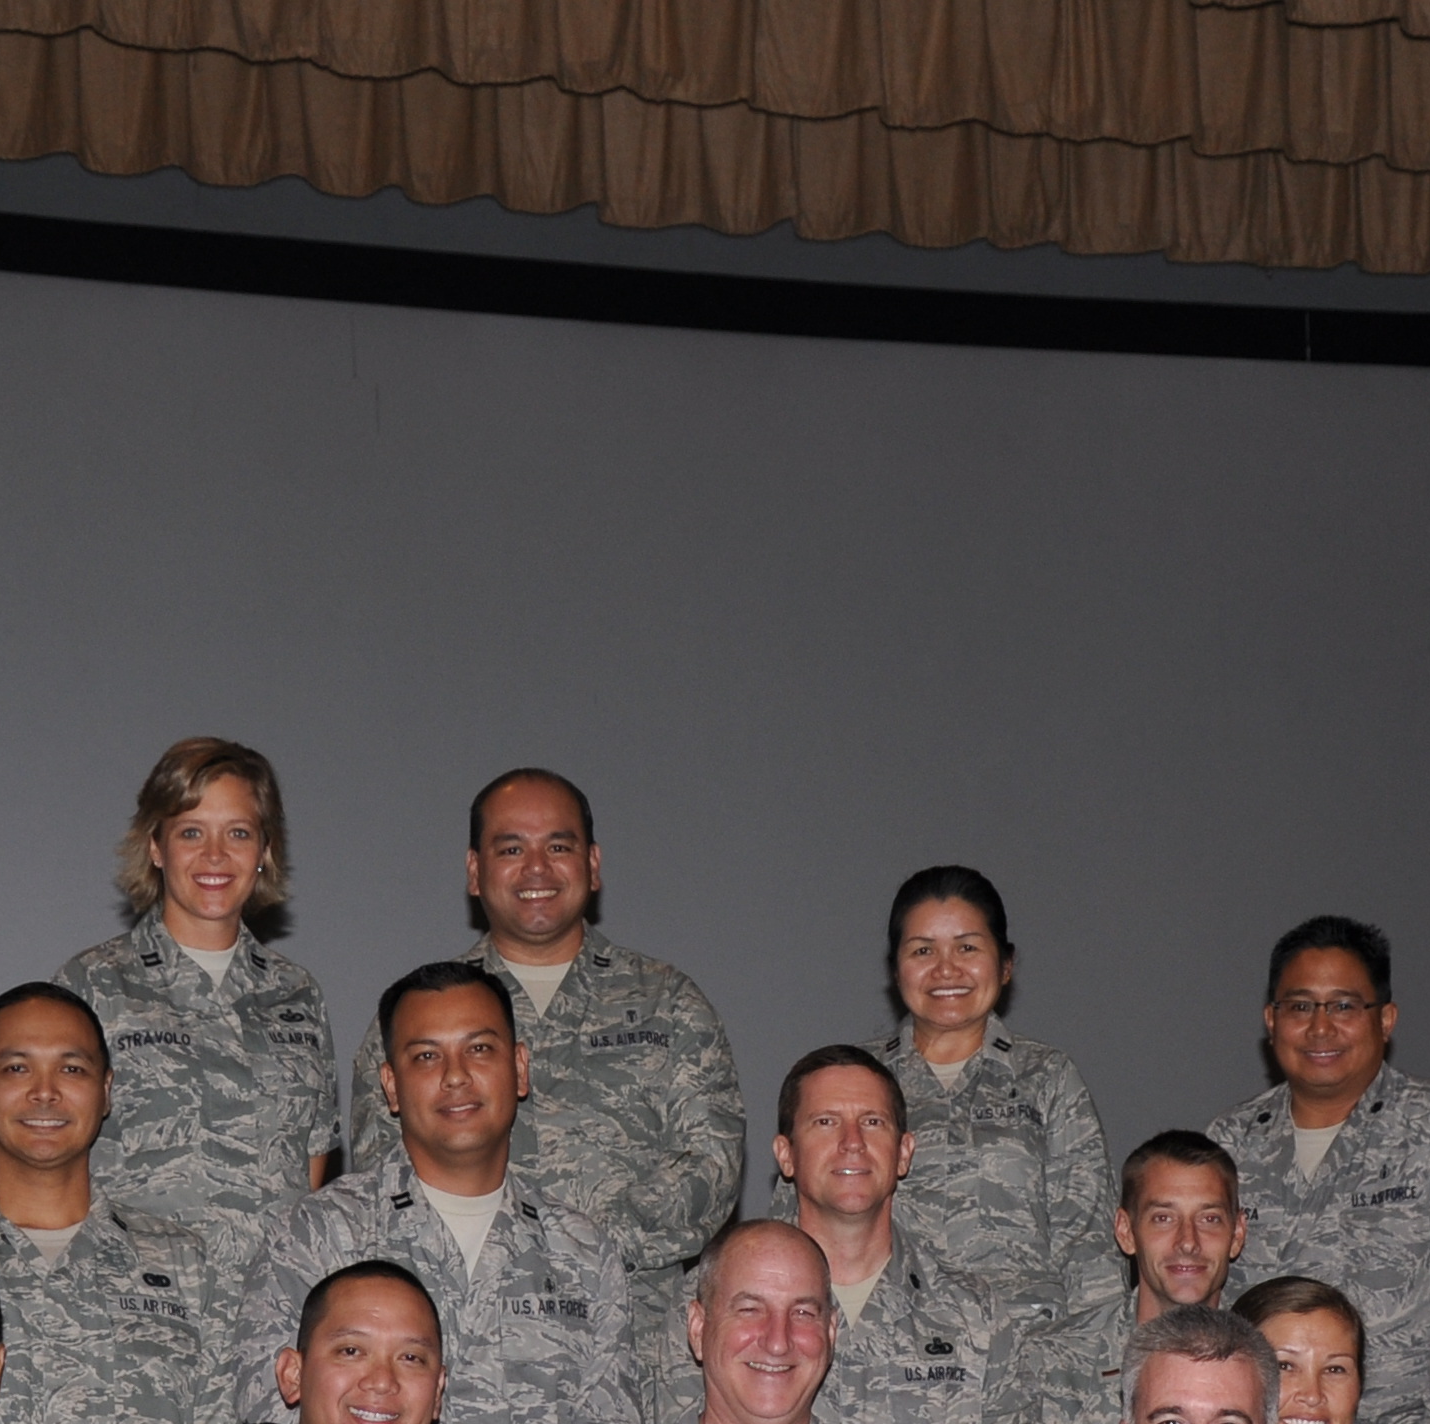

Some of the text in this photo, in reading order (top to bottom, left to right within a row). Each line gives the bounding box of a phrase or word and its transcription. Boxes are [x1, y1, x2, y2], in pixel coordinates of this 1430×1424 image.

[117, 1031, 191, 1051] STRAVOLO
[590, 1031, 670, 1049] U.S. AIR FORCE
[1351, 1193, 1369, 1208] U.S.
[119, 1297, 140, 1311] U.S.
[142, 1298, 160, 1313] AIR
[511, 1299, 589, 1320] U.S. AIR FORCE
[905, 1367, 926, 1382] U.S.
[927, 1366, 945, 1382] AIR
